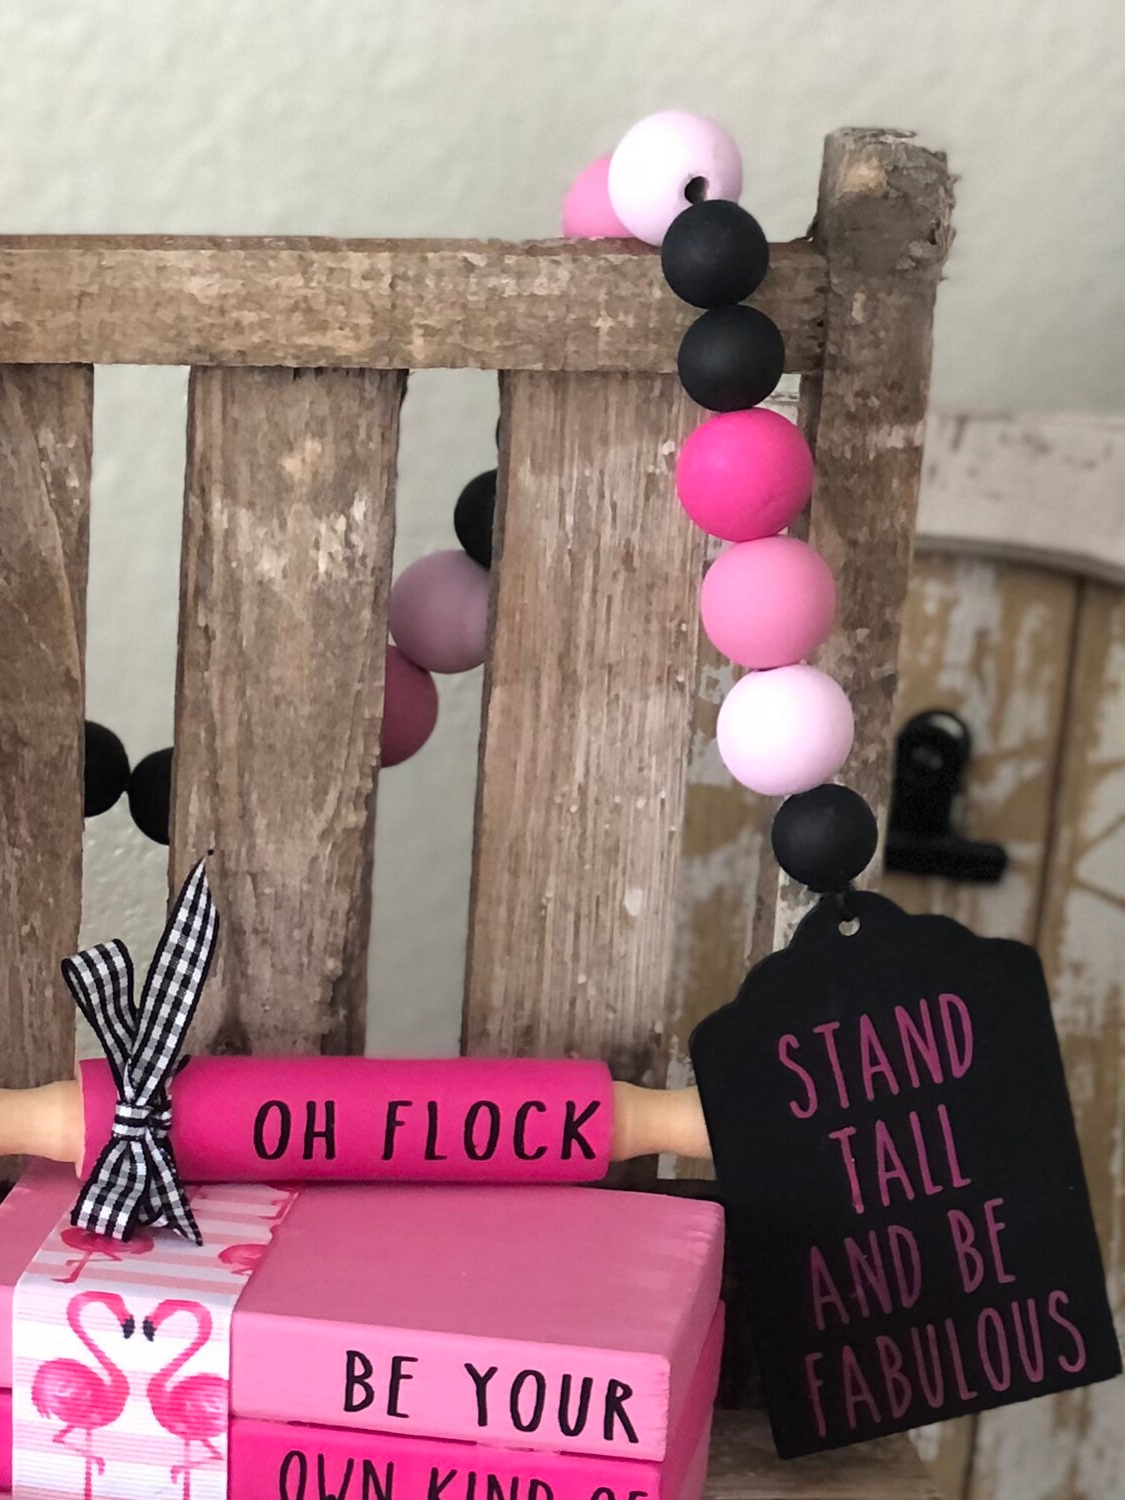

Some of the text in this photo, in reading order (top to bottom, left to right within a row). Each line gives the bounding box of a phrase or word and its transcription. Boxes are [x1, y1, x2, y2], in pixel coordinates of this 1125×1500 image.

[779, 993, 974, 1119] STAND
[253, 1100, 603, 1161] OH FLOCK
[828, 1104, 971, 1214] TALL
[810, 1198, 1016, 1330] AND BE
[344, 1350, 639, 1443] BE YOUR
[804, 1290, 1086, 1437] FABULOUS
